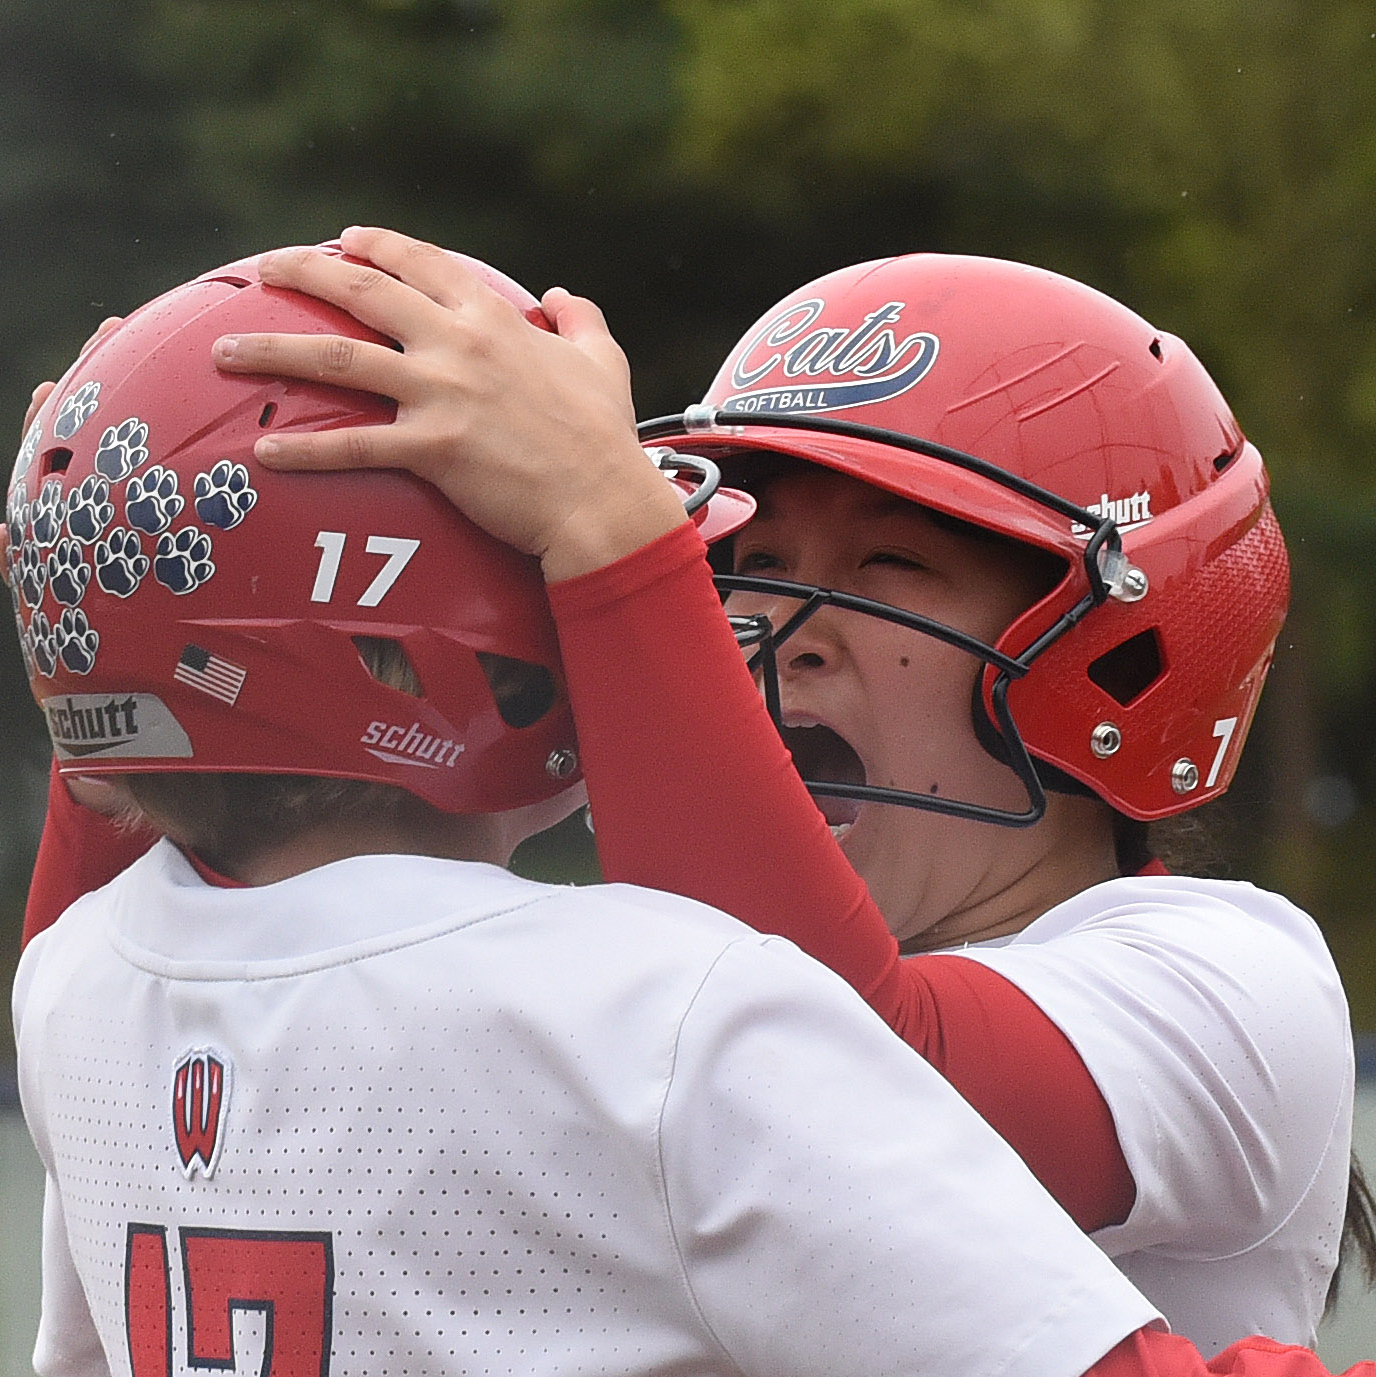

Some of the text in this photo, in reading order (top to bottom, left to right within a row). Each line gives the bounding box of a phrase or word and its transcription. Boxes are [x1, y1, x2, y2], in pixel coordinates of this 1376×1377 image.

[731, 298, 939, 388] Cats
[735, 391, 828, 413] SOFTBALL
[310, 530, 421, 607] 17
[48, 695, 139, 740] schutt
[360, 720, 465, 767] schutt
[1205, 716, 1238, 788] 7
